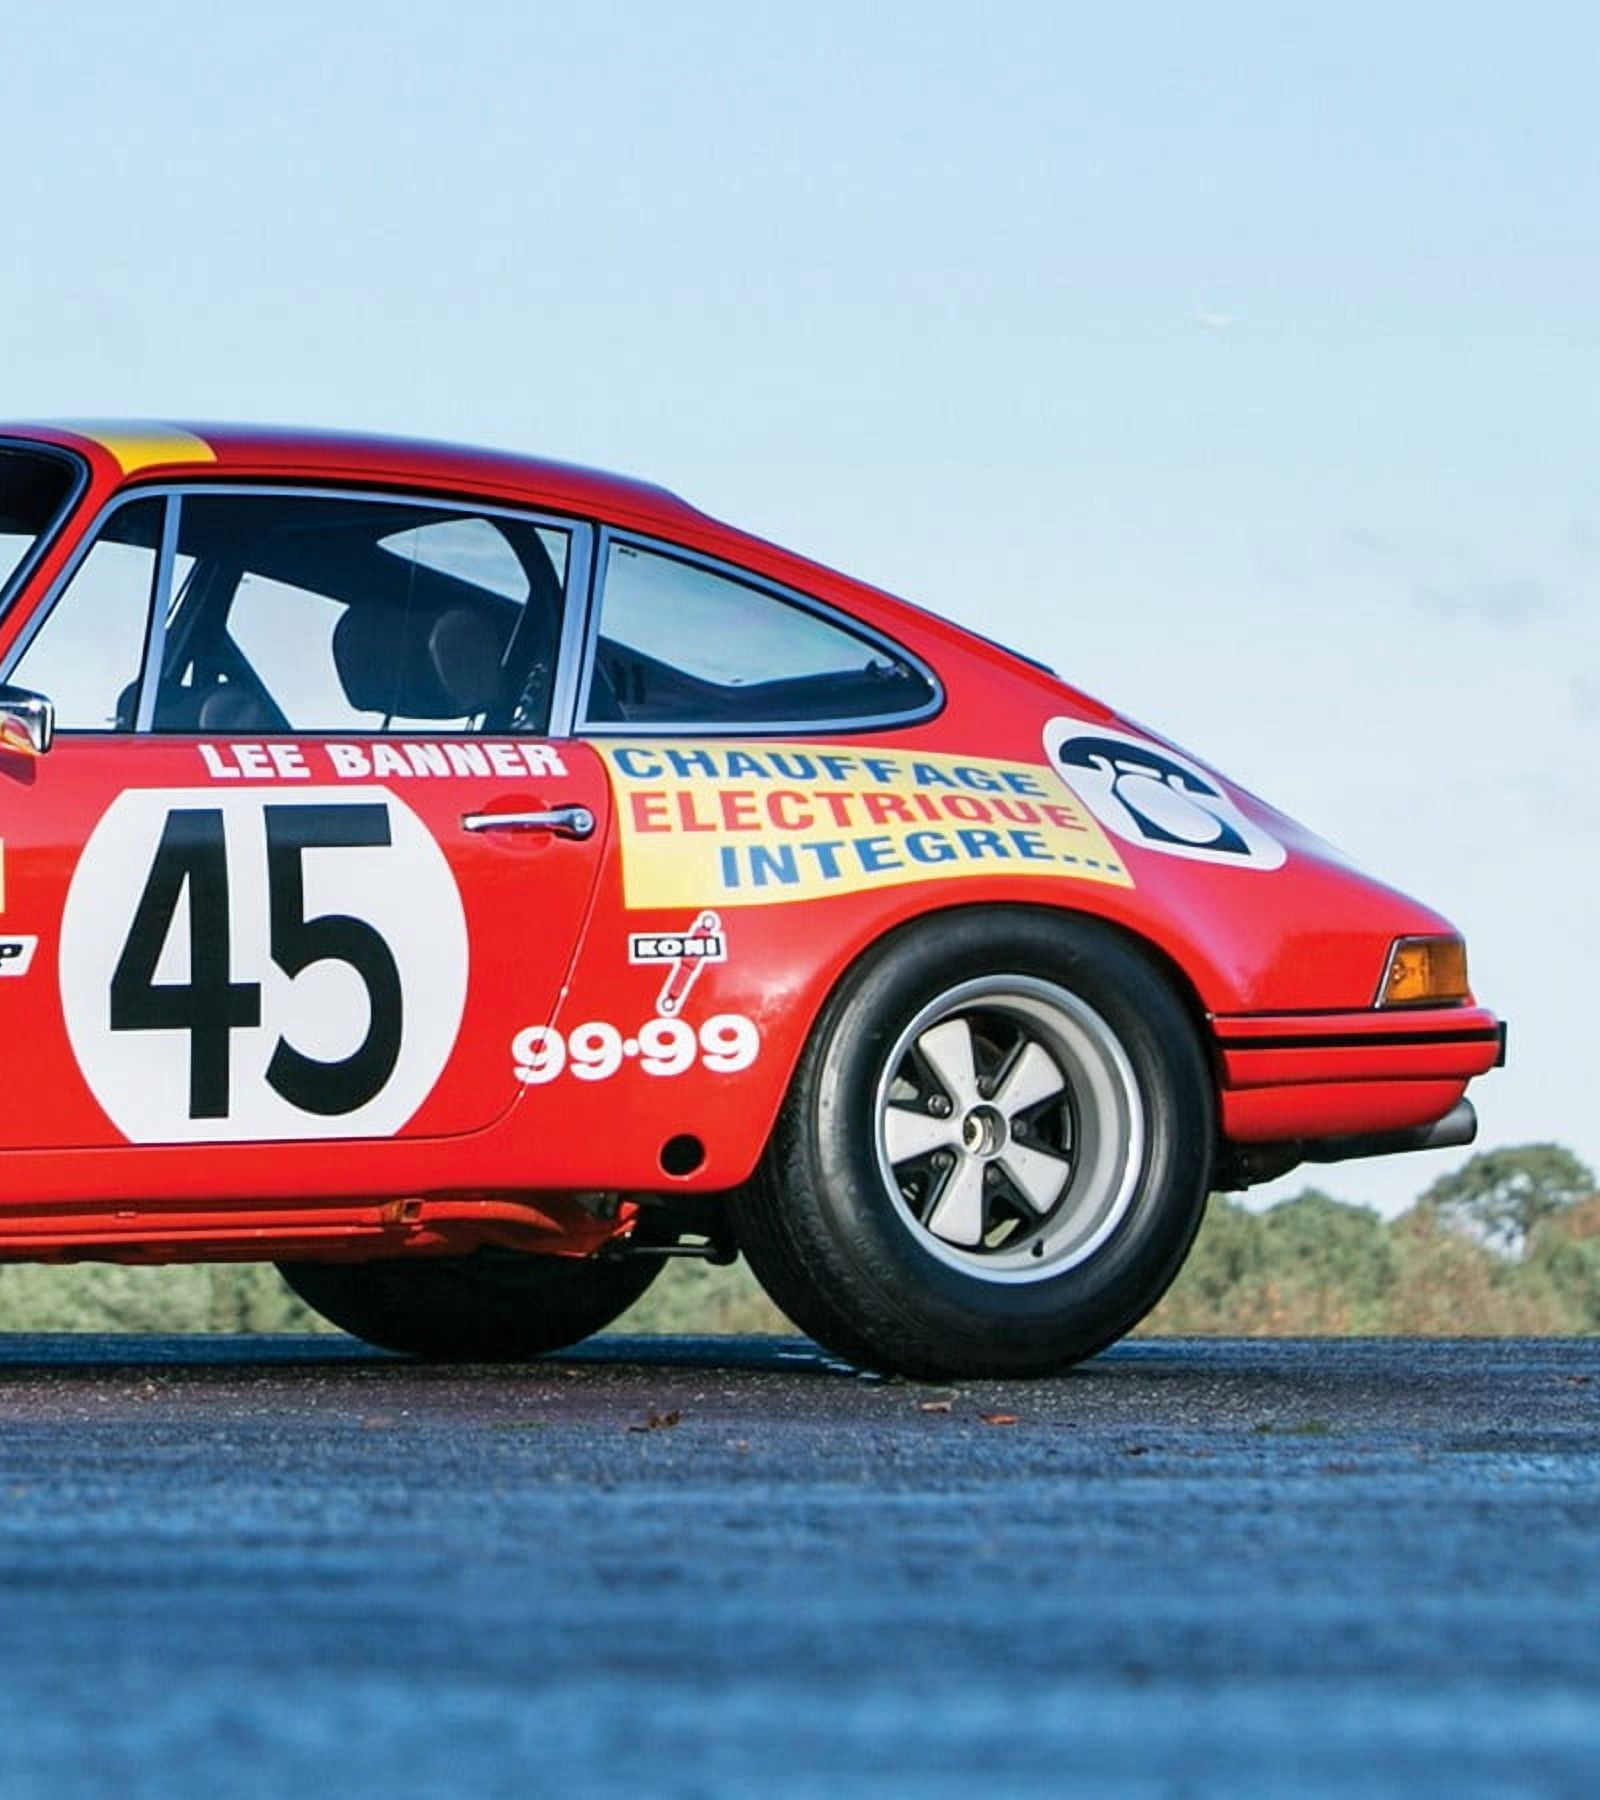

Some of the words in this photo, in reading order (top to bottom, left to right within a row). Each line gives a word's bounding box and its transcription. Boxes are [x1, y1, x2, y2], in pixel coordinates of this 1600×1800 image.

[199, 743, 310, 778] LEE
[325, 743, 568, 777] BANNER
[612, 747, 1048, 797] CHAUFFAGE
[630, 791, 1087, 833] ELECTRIQUE
[110, 803, 404, 1119] 45
[636, 937, 719, 957] KONI
